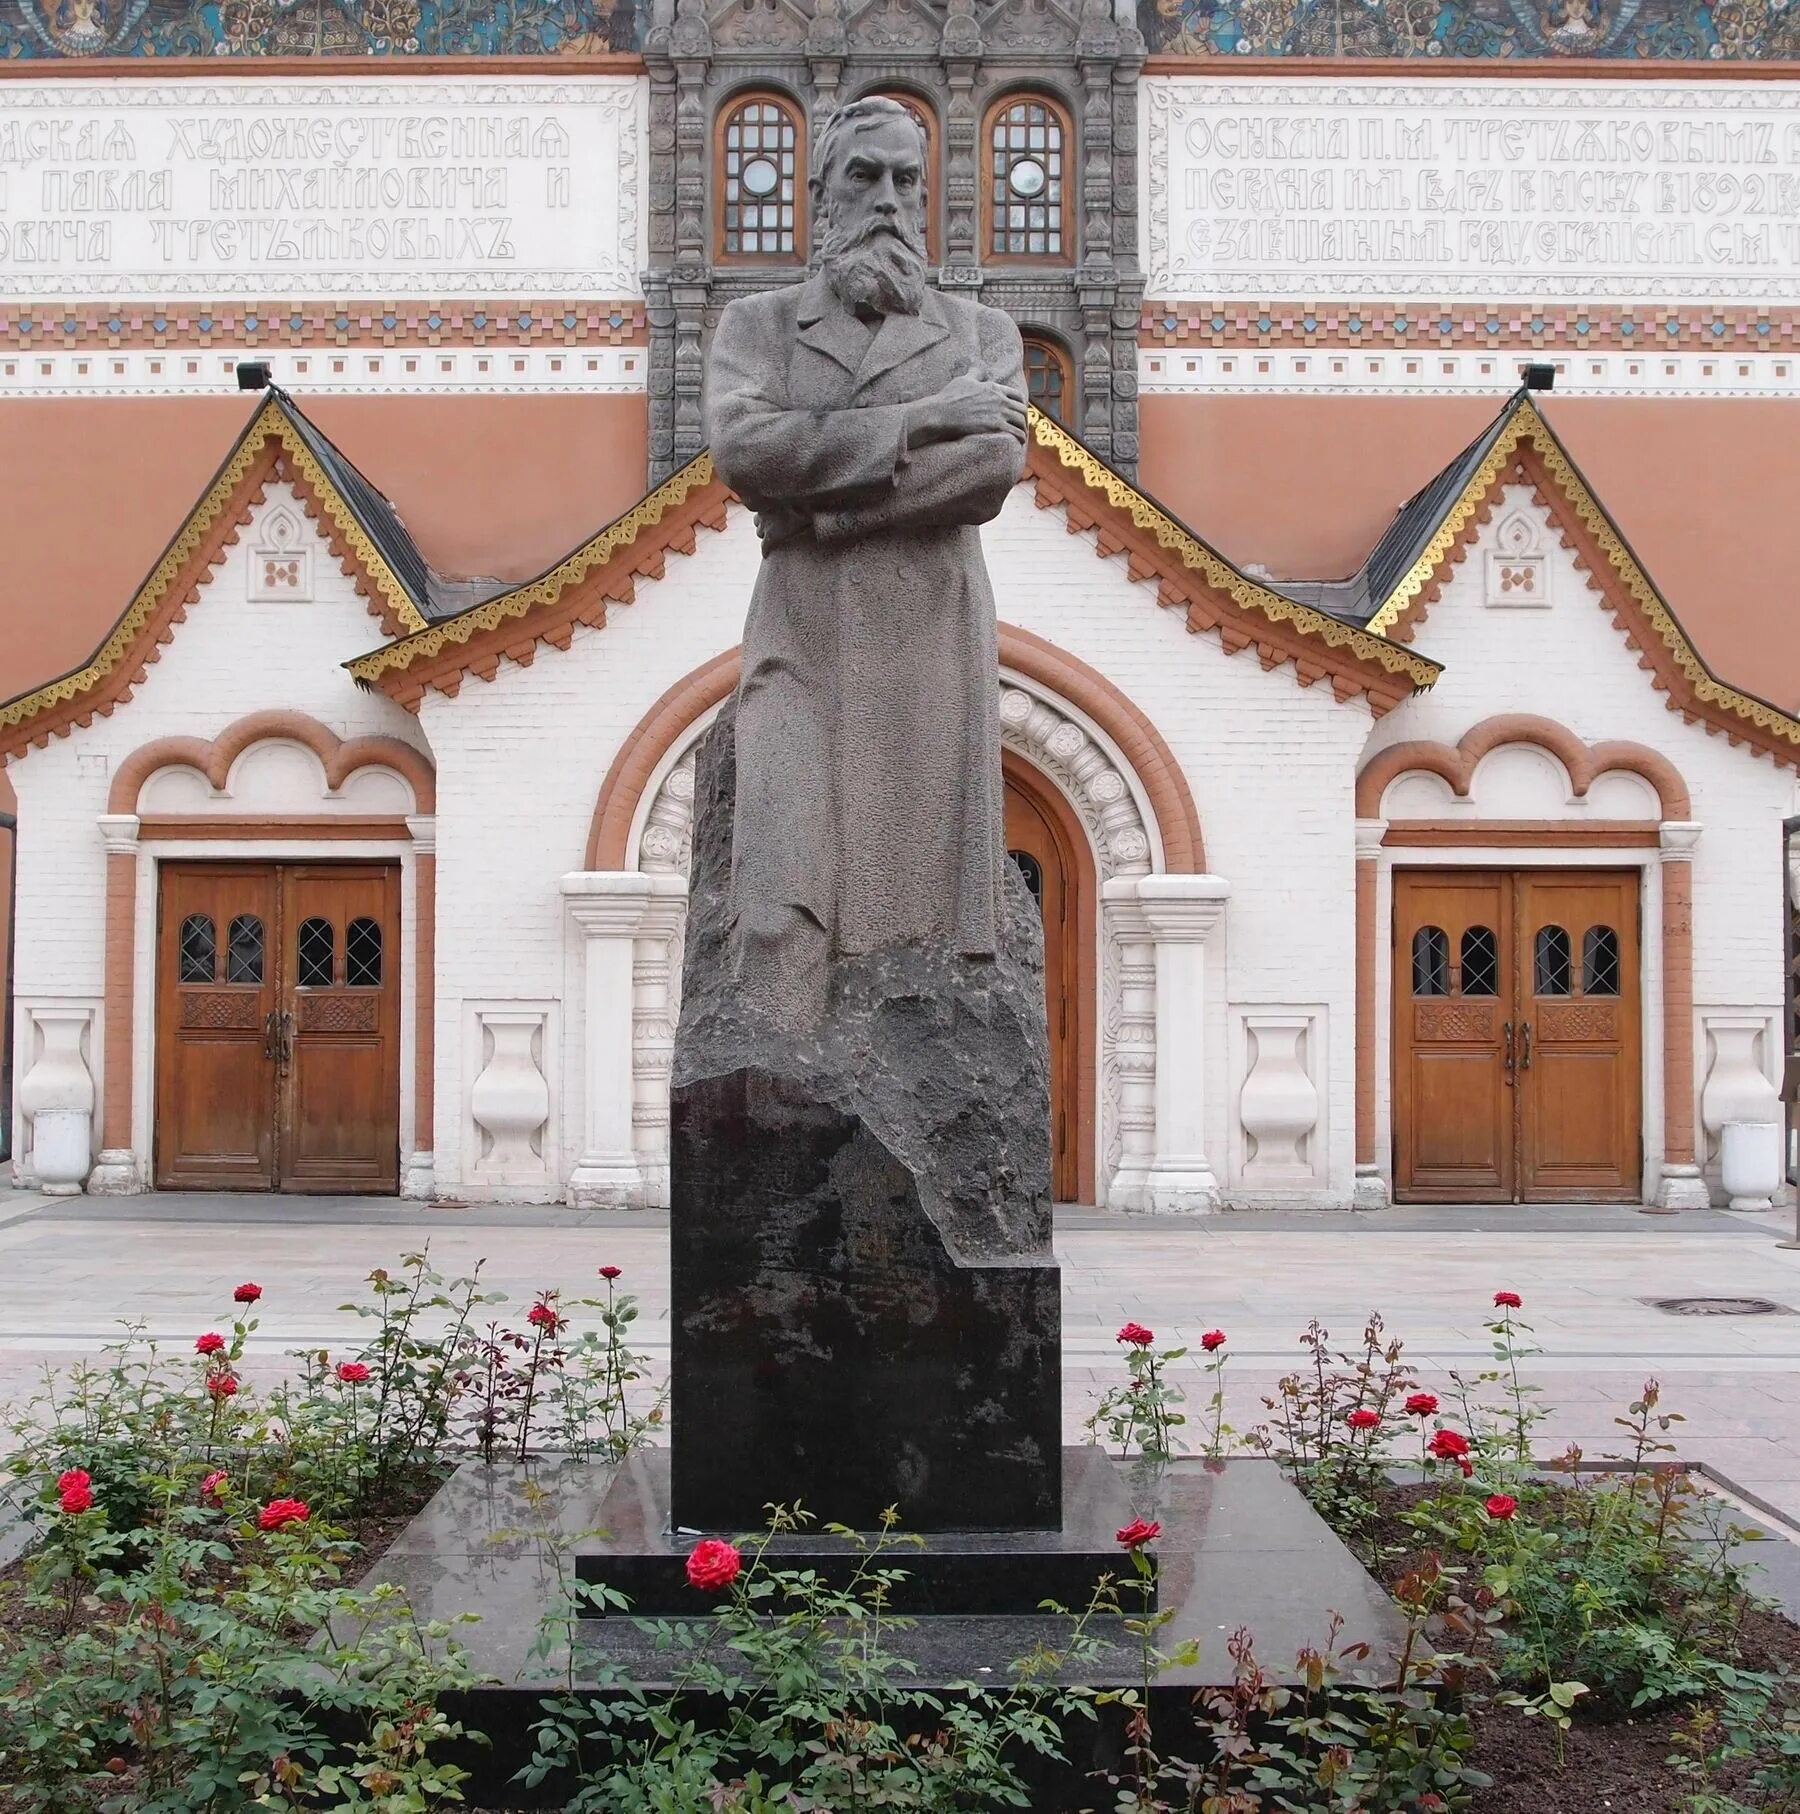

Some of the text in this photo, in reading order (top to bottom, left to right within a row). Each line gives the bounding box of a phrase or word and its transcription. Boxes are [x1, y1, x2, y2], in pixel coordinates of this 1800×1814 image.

[42, 168, 172, 211] ПАВЛА
[210, 160, 508, 211] МИХАЙЛОВИЧА
[547, 167, 570, 209] И
